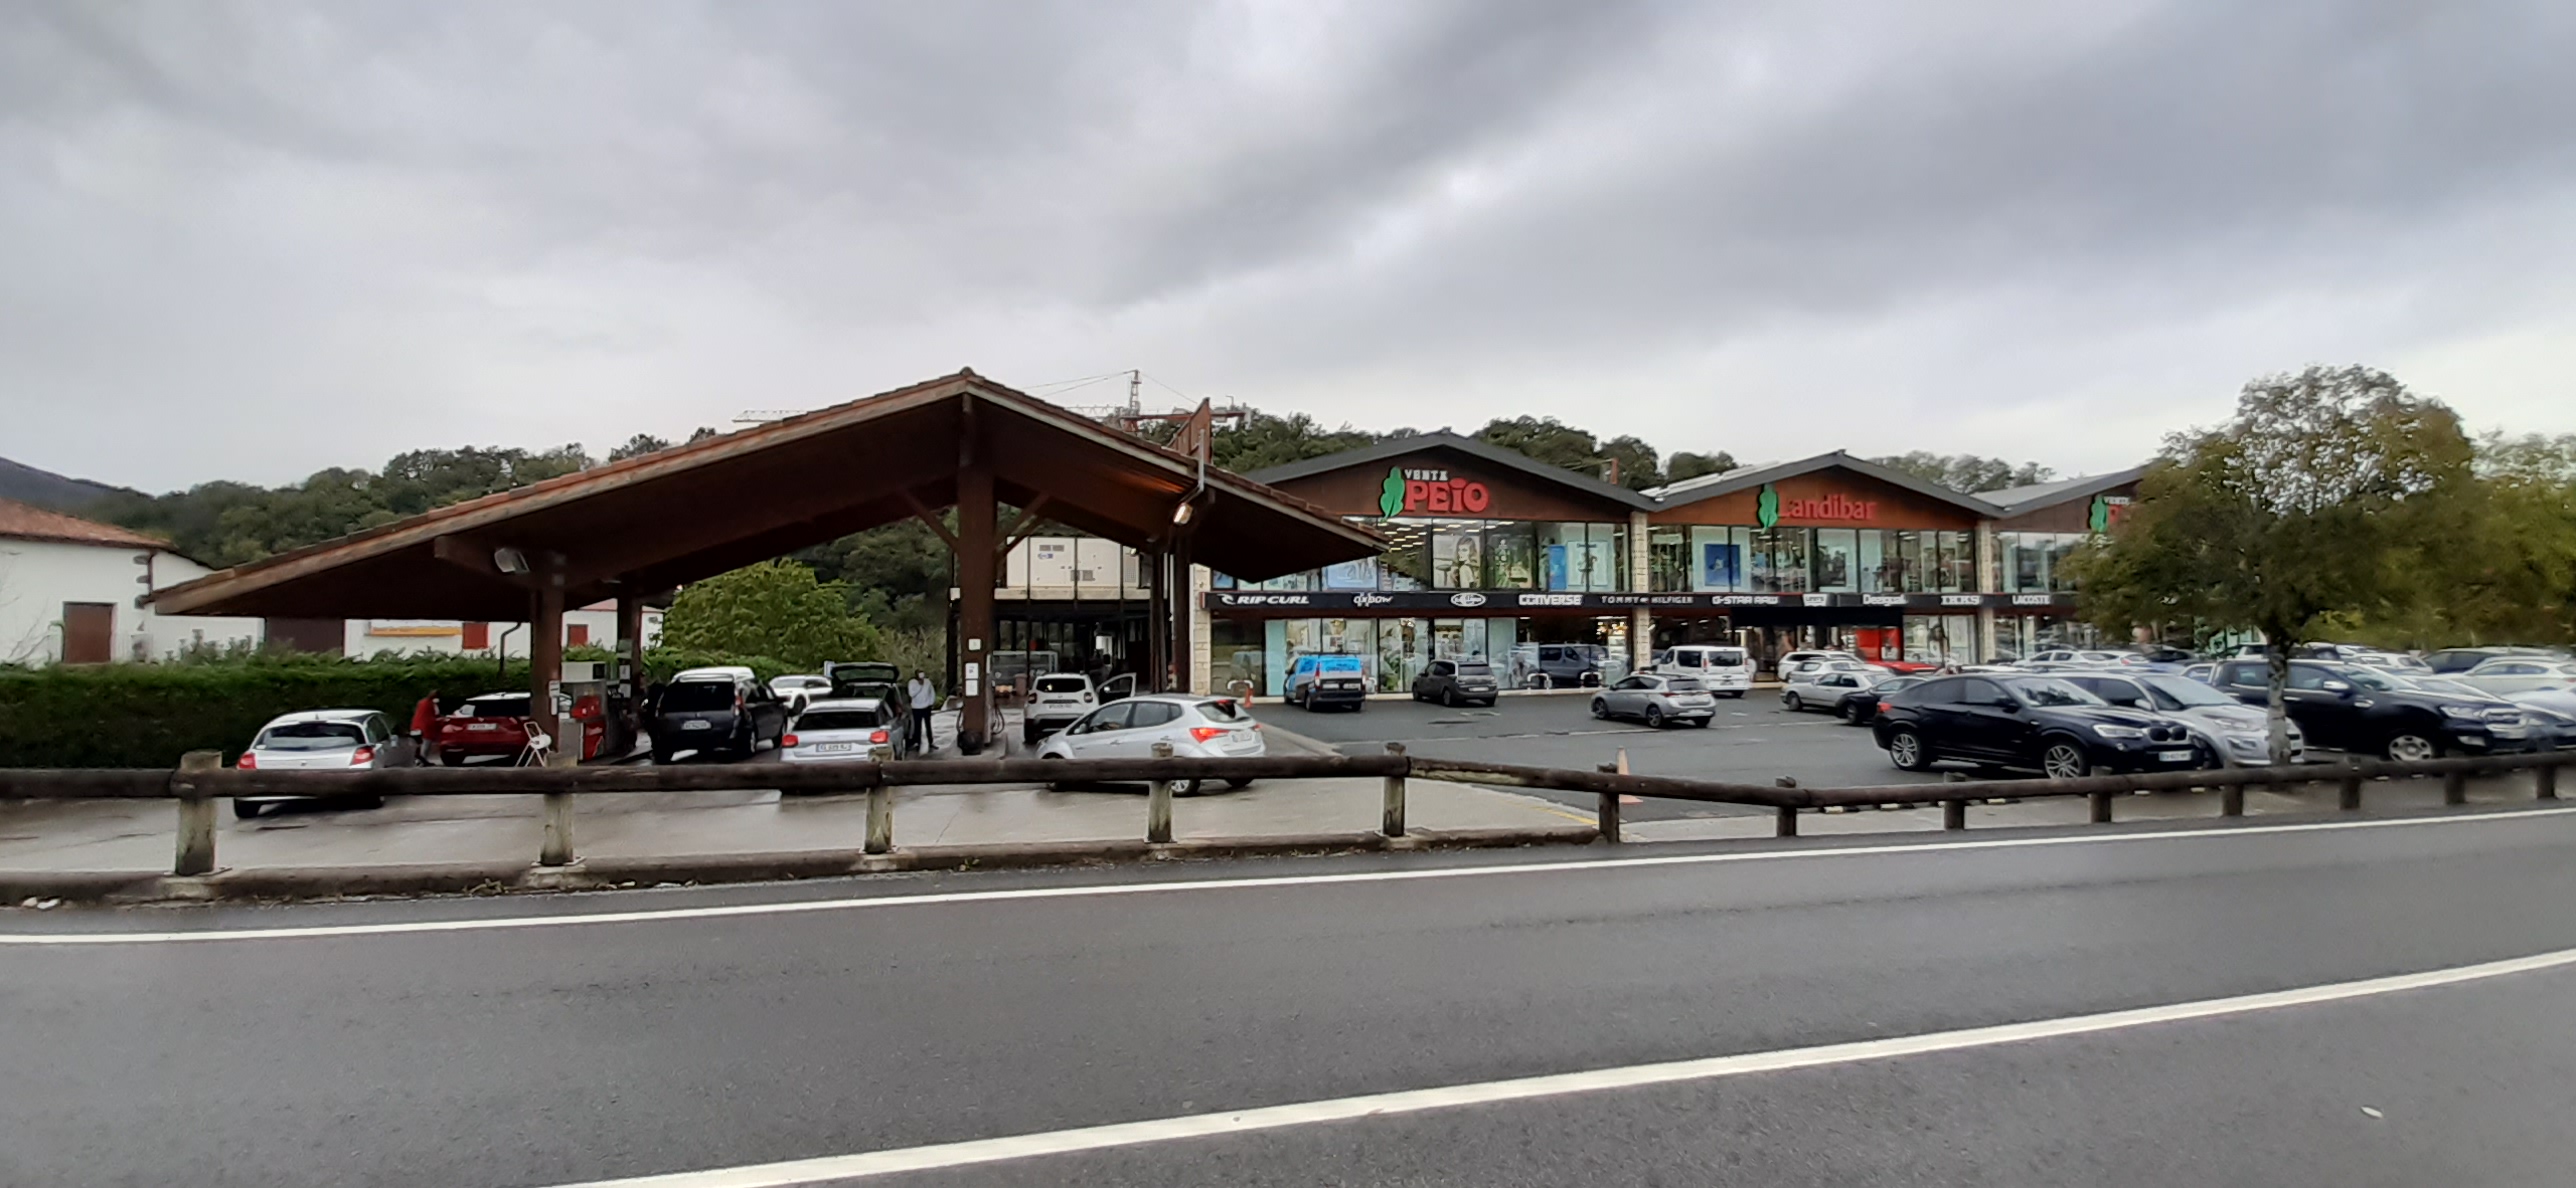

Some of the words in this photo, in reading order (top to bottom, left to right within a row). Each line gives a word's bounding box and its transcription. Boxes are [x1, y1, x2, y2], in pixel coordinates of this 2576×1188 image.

[1779, 494, 1877, 519] Landibar
[1237, 595, 1266, 605] RIP
[1267, 595, 1310, 605] CURL
[1518, 594, 1583, 606] CONVERSE
[1601, 596, 1639, 604] TOMMY
[1711, 595, 1751, 605] G-STAR
[2012, 595, 2051, 605] LACOSTE
